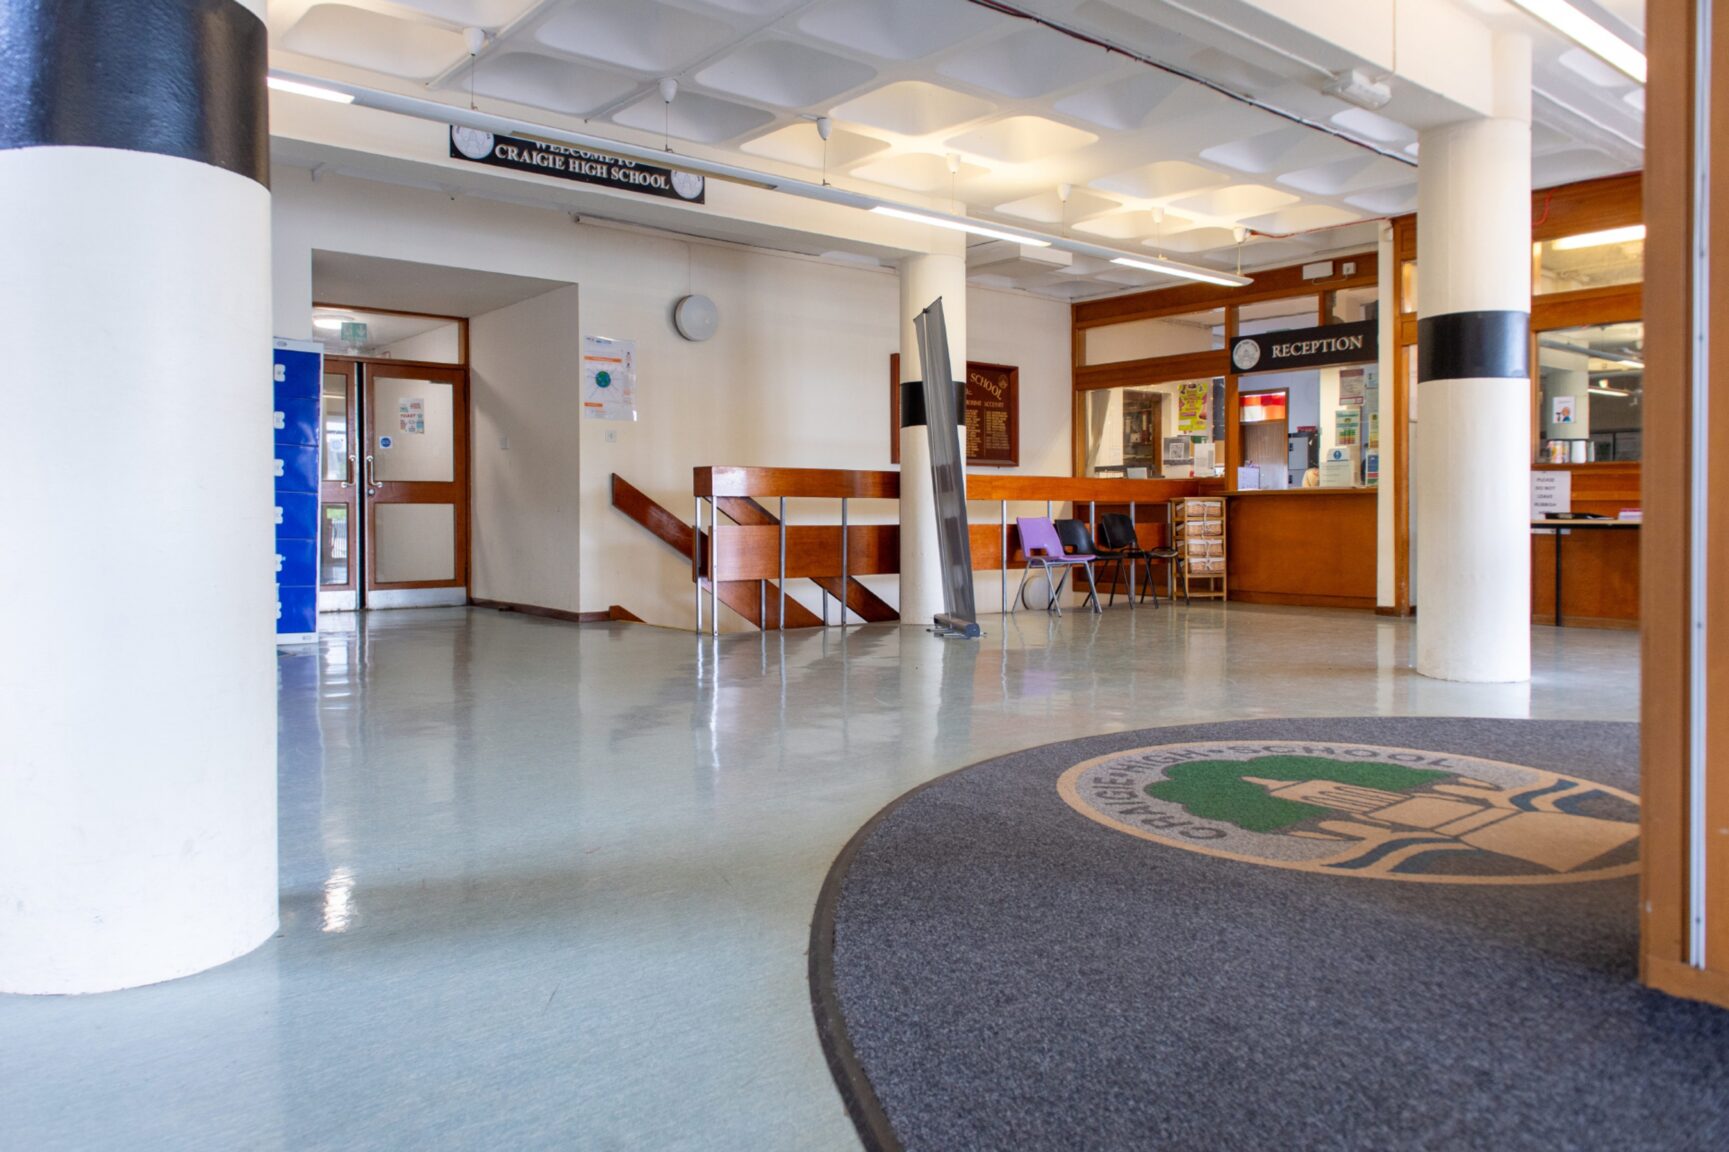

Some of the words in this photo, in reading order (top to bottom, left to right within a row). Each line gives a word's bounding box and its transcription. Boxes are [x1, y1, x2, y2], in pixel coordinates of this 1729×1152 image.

[494, 143, 566, 170] CRAIGIE
[568, 158, 609, 178] HIGH
[610, 166, 670, 190] SCHOOL
[1271, 334, 1364, 359] RECEPTION
[970, 372, 1003, 401] SCHOOL
[1108, 749, 1209, 774] HIGH
[1227, 744, 1455, 768] SCHOOL
[1092, 776, 1227, 840] CRAIGIE
